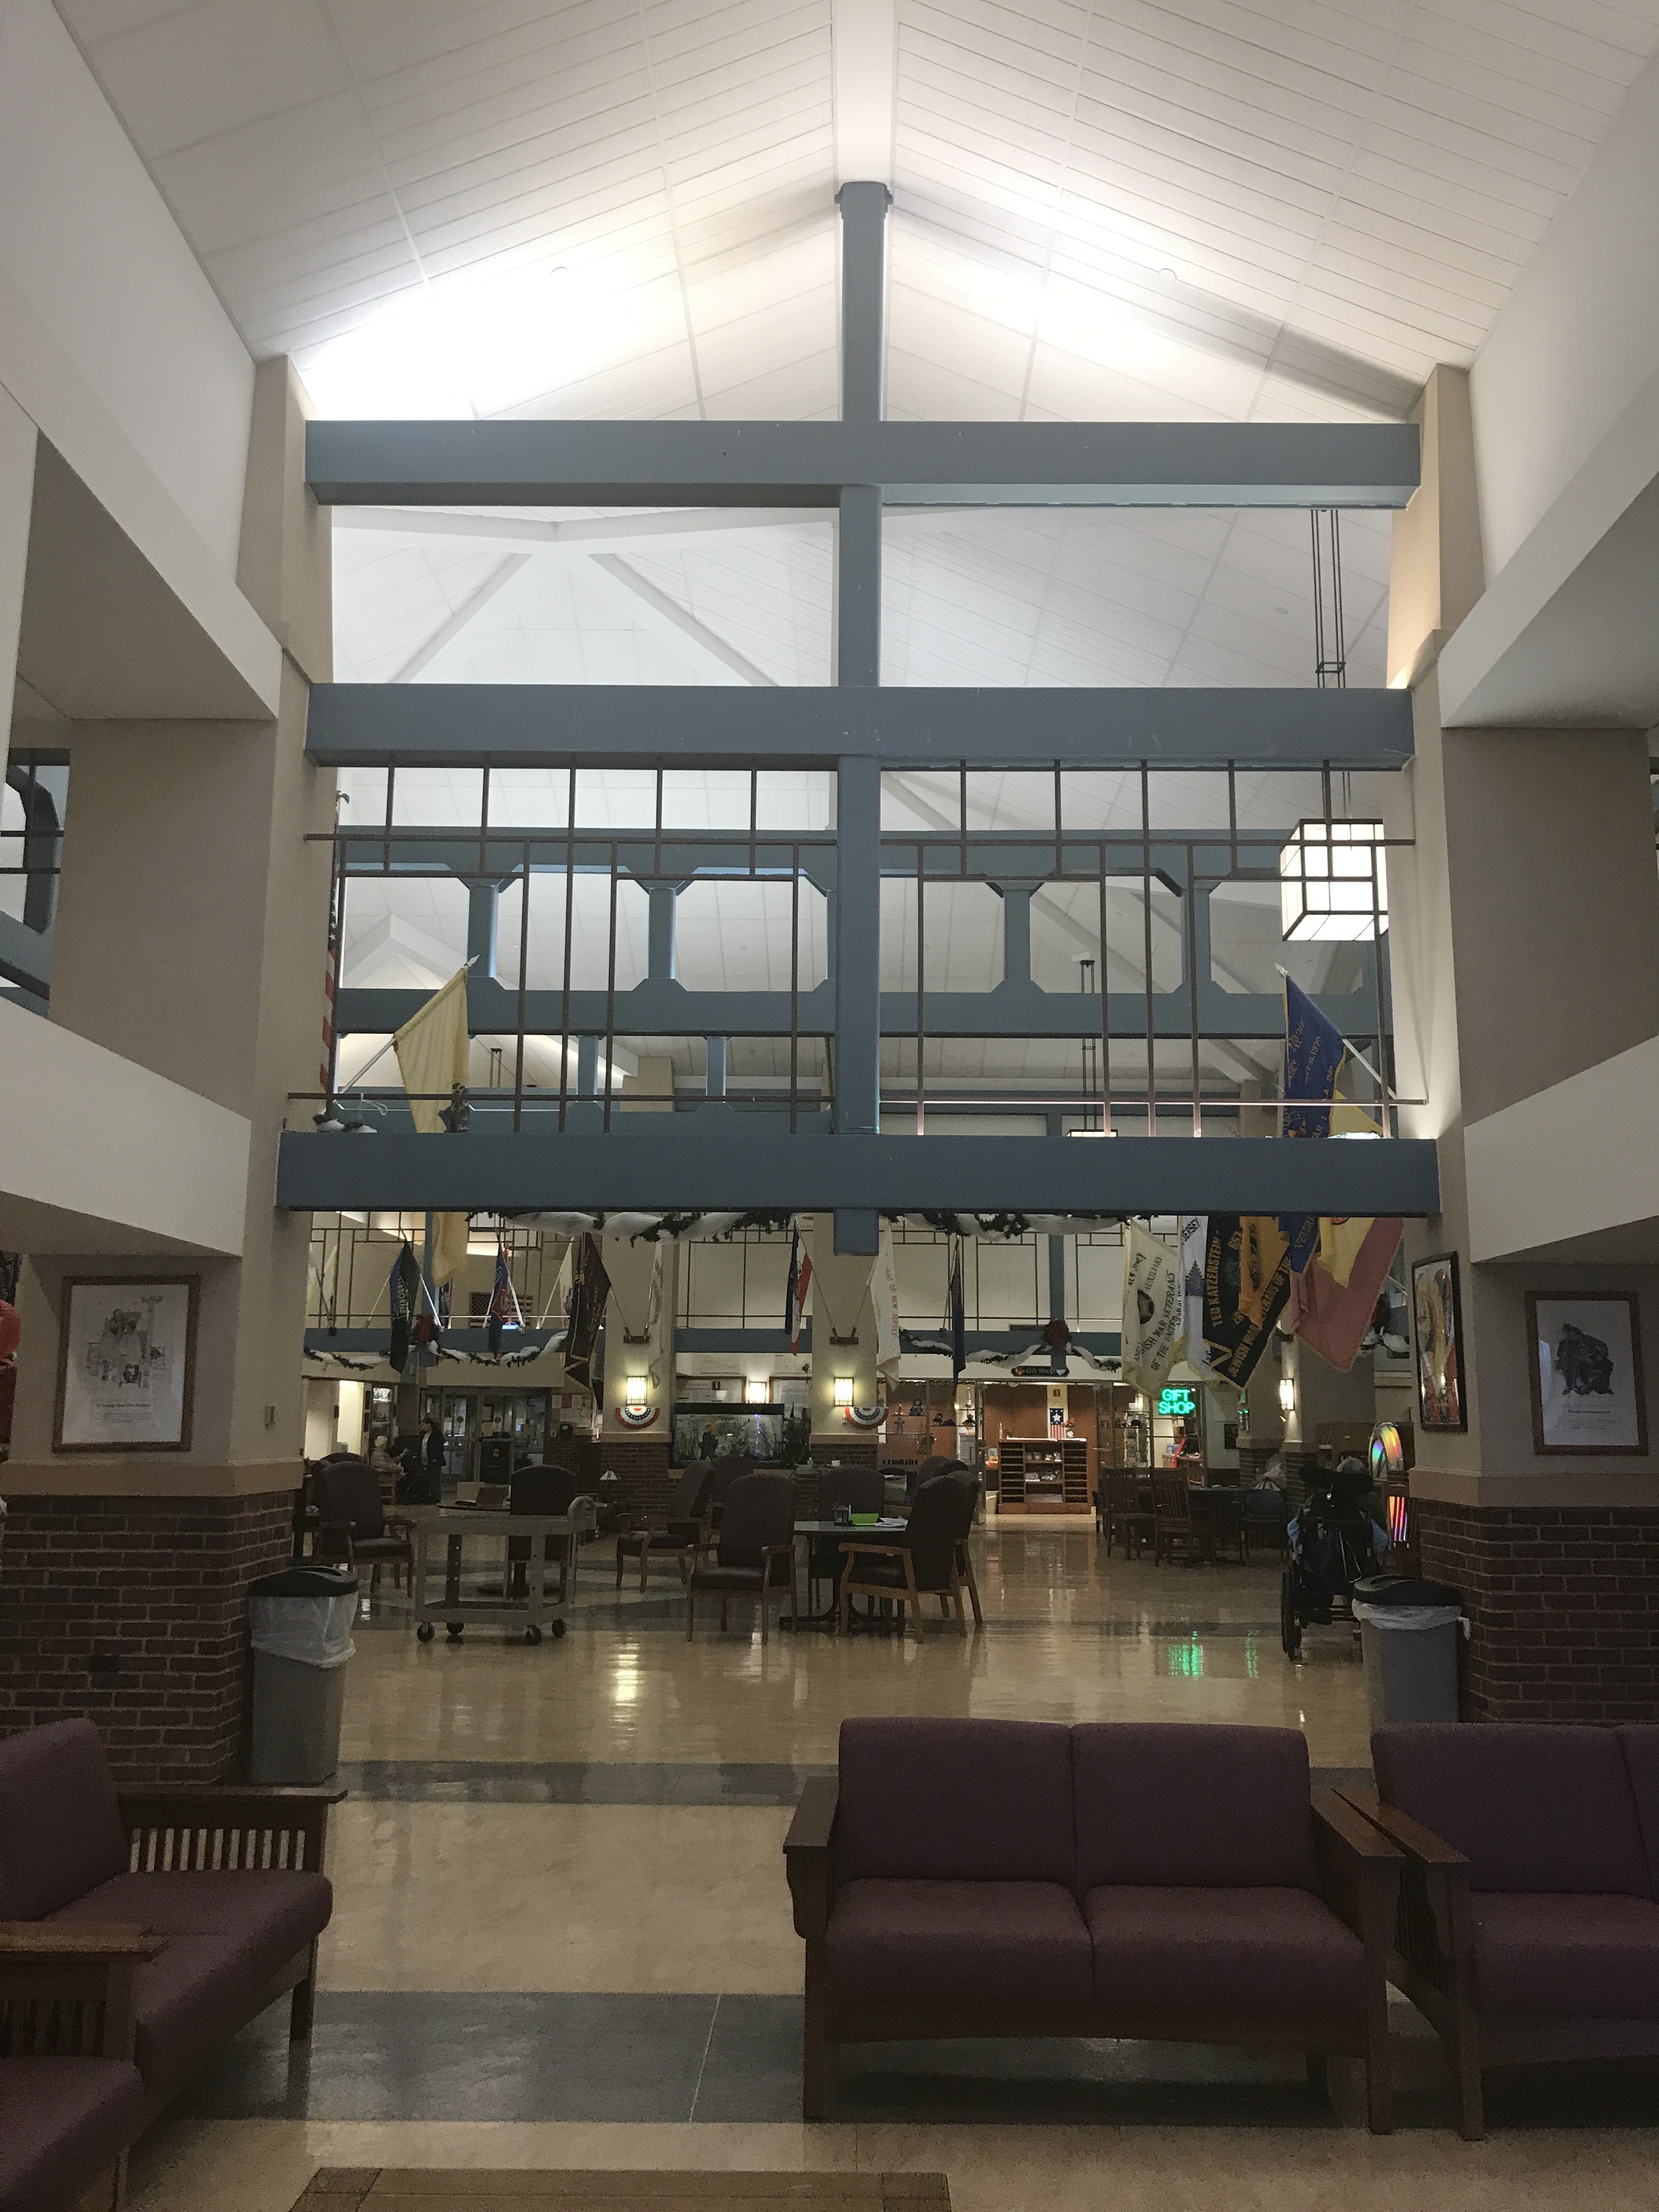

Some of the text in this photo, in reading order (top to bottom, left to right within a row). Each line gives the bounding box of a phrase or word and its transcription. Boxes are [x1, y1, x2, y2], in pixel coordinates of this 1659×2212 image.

[1153, 1320, 1168, 1338] WAR
[1163, 1268, 1176, 1319] VETERANS
[1210, 1306, 1223, 1328] TED
[1150, 1358, 1160, 1370] OF
[1156, 1343, 1169, 1358] THE
[1161, 1389, 1190, 1401] GIFT
[1159, 1401, 1195, 1414] SHOP
